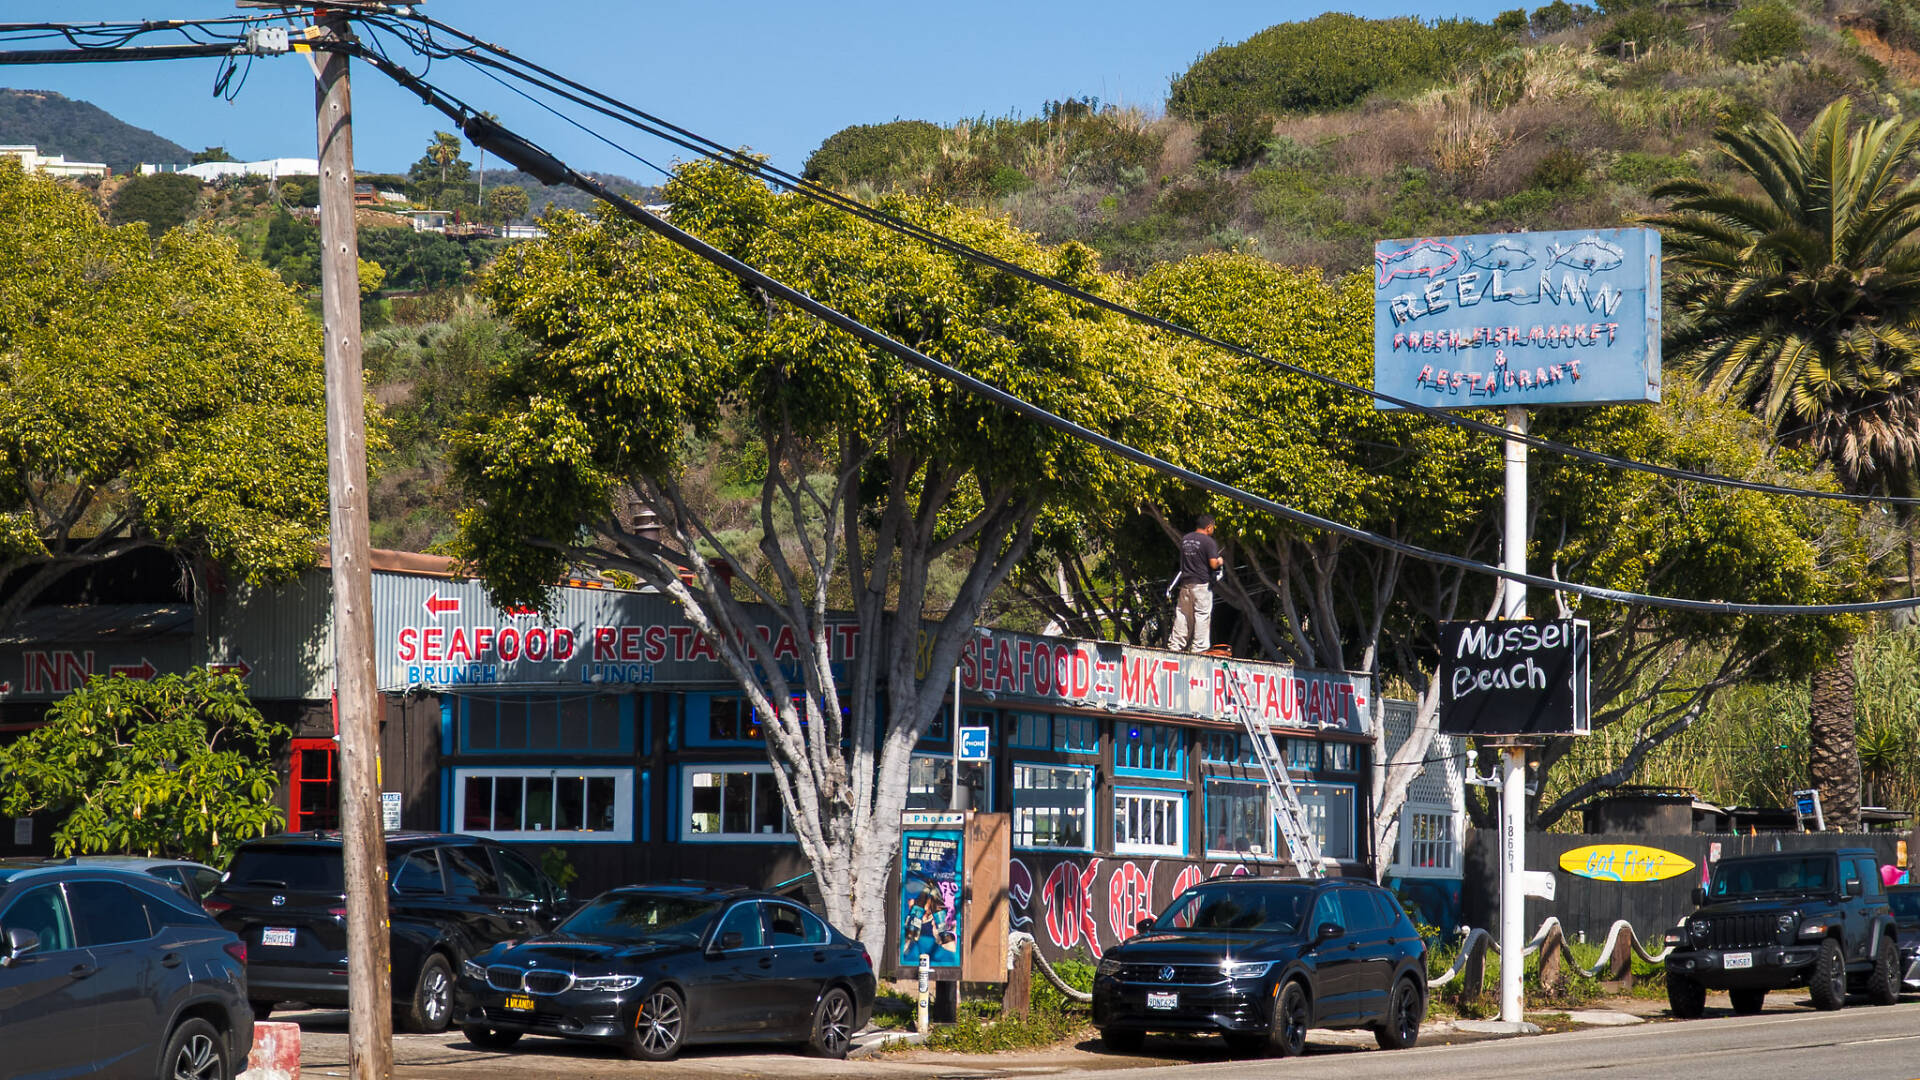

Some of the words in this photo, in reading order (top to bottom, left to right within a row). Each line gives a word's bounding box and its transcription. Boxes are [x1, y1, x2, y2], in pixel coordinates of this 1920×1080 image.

[1391, 269, 1512, 325] REEL
[1540, 270, 1622, 317] INN
[1394, 329, 1461, 349] FRESH
[1473, 326, 1520, 344] FISH
[1528, 323, 1619, 343] MARKET
[1495, 350, 1506, 366] &
[1418, 360, 1581, 393] RESTAURANT
[397, 626, 574, 662] SEAFOOD
[593, 625, 860, 662] RESTARANT
[1457, 623, 1568, 660] Mussel
[22, 651, 94, 693] INN
[408, 664, 497, 684] BRUNCH
[581, 664, 654, 684] LUNCH
[962, 636, 1090, 698] SEAFOOD
[1120, 654, 1180, 708] MKT
[1213, 667, 1354, 727] RESTAURANT
[1452, 657, 1546, 700] Beach
[914, 815, 952, 823] Phone
[908, 852, 930, 860] MAKE
[925, 840, 957, 848] FRIENDS
[1586, 850, 1616, 873] Got
[1042, 858, 1104, 959] THE
[1109, 860, 1158, 943] REEL
